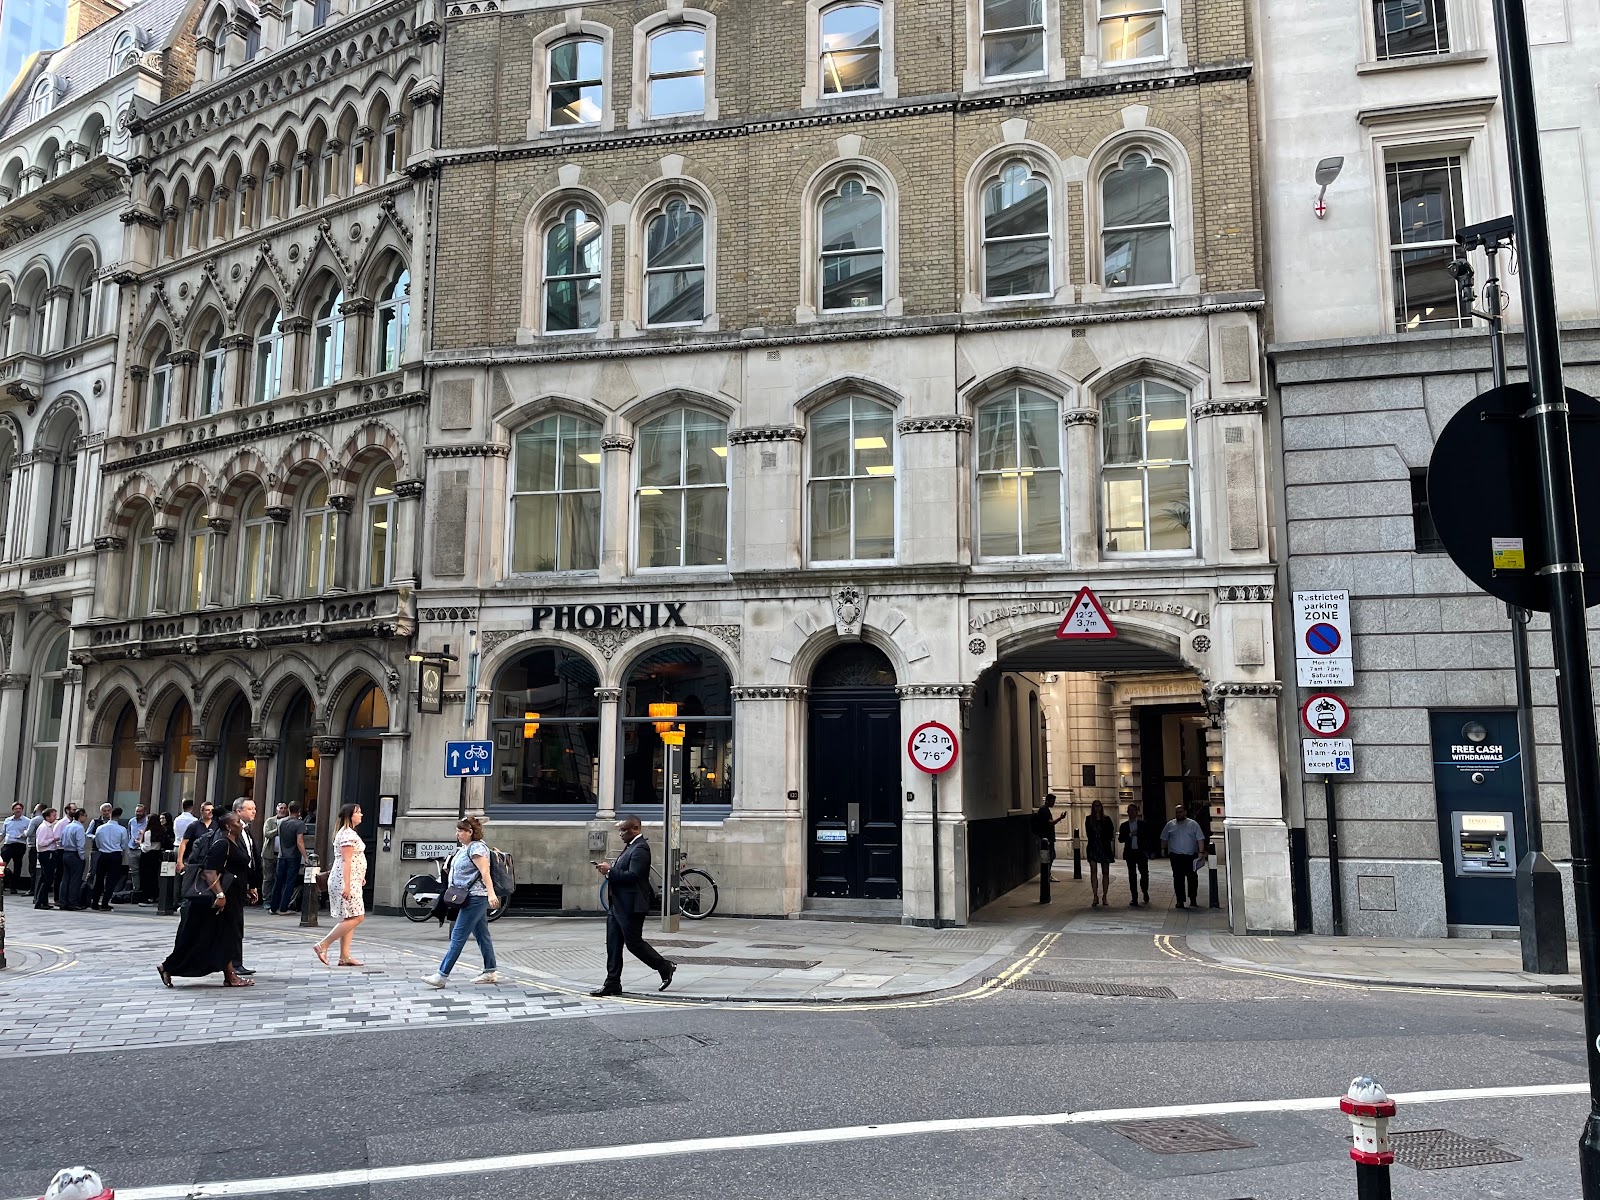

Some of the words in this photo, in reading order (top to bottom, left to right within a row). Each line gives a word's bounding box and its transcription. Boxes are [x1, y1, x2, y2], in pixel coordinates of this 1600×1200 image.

[1133, 599, 1183, 615] FRIARS
[1304, 602, 1338, 610] parking
[531, 602, 688, 630] PHOENIX
[1305, 612, 1338, 620] ZONE
[1451, 745, 1475, 753] FREE
